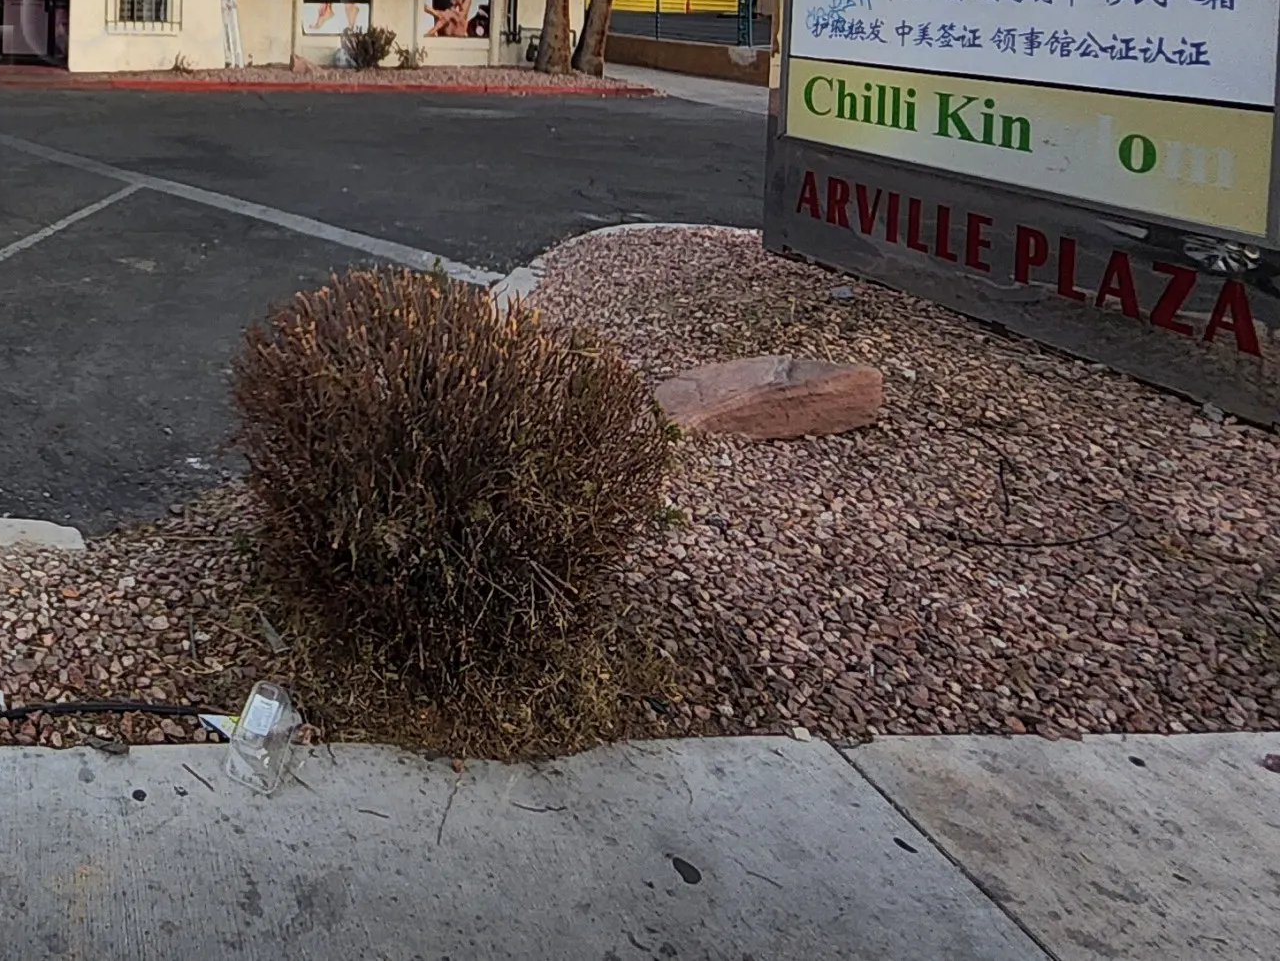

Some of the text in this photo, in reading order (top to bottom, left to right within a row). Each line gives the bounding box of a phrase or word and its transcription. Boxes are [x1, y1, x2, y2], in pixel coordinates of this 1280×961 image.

[894, 21, 983, 52] 中美签证
[990, 25, 1211, 67] 领事馆公证认证
[803, 76, 917, 132] Chilli
[796, 171, 1262, 357] ARVILLE PLAZA
